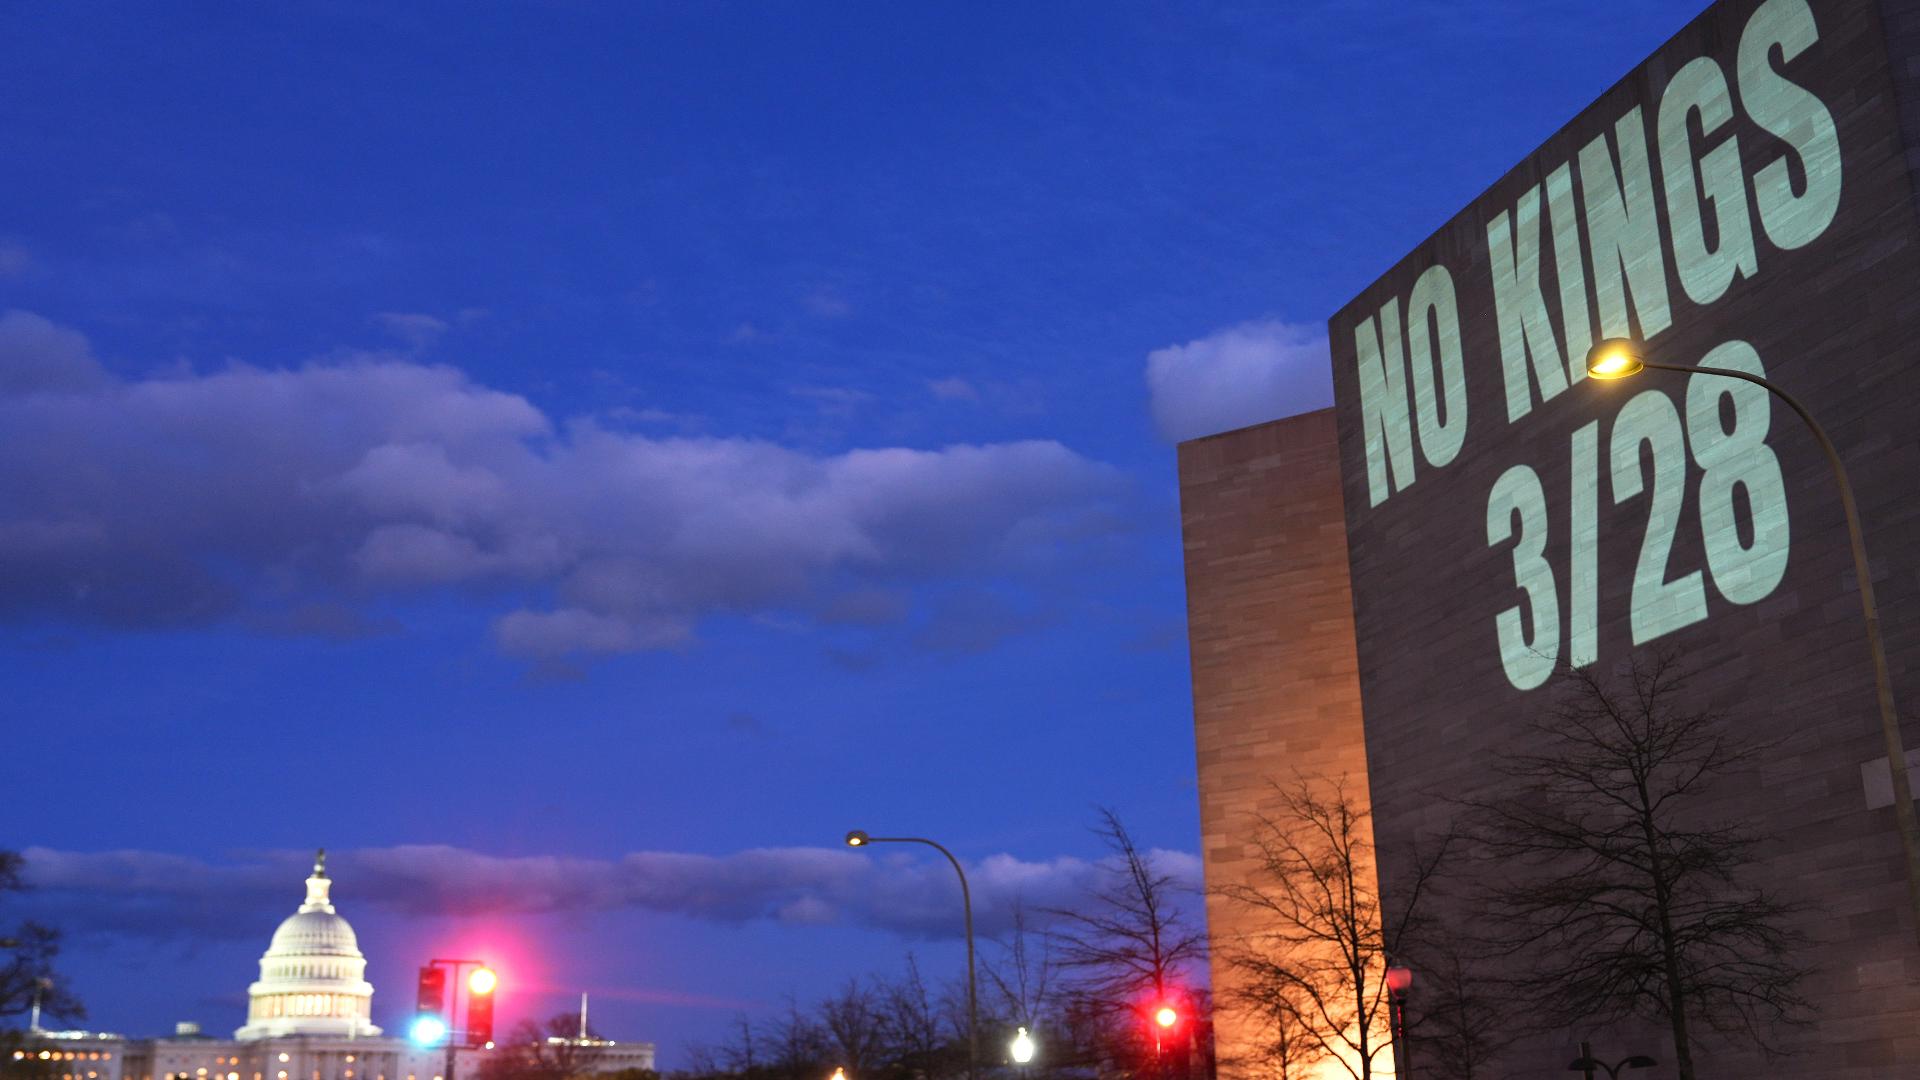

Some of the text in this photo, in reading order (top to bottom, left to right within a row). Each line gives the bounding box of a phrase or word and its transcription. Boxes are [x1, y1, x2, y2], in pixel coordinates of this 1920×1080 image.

[1355, 0, 1842, 509] NO KINGS
[1486, 340, 1790, 691] 3/28
